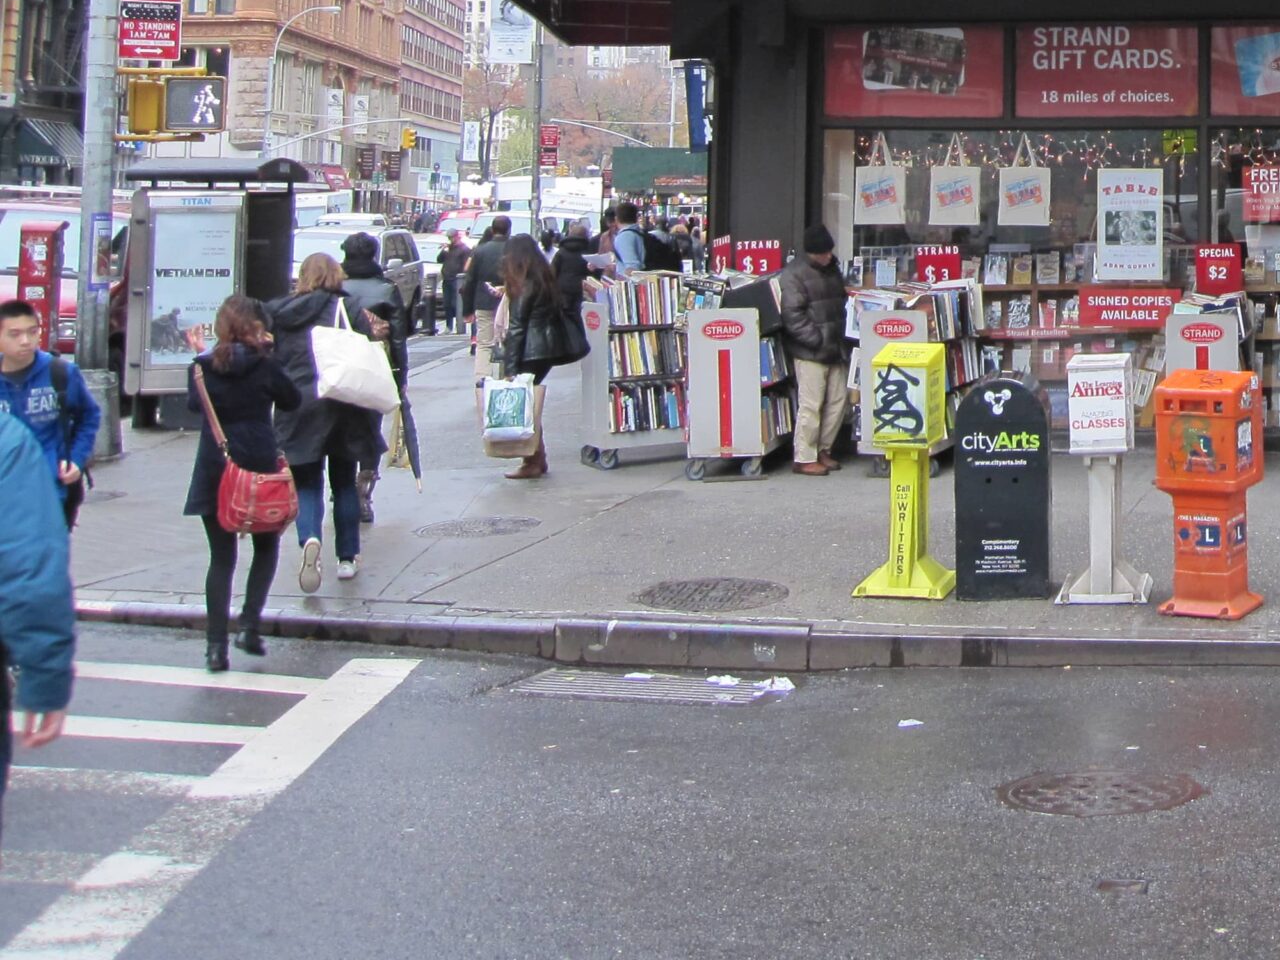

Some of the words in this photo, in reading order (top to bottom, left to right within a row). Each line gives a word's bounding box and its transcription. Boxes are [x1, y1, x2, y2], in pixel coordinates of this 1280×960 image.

[124, 21, 135, 30] NO
[138, 22, 176, 31] STANDING
[1033, 26, 1130, 47] STRAND
[1033, 49, 1086, 70] GIFT
[1094, 48, 1181, 69] CARDS.
[1041, 91, 1059, 103] 18
[1063, 90, 1098, 103] miles
[1102, 90, 1116, 103] of
[1119, 90, 1174, 103] choices.
[1102, 183, 1158, 196] TABLE
[181, 197, 212, 206] TITAN
[737, 240, 780, 250] STRAND
[917, 245, 959, 256] STRAND
[1199, 248, 1235, 257] SPECIAL
[156, 268, 204, 278] VIETNAM
[215, 268, 231, 278] HD
[1208, 265, 1228, 279] $2
[1087, 295, 1129, 306] SIGNED
[1132, 295, 1172, 306] COPIES
[1101, 309, 1159, 321] AVAILABLE
[705, 325, 742, 335] STRAND
[876, 324, 911, 333] STRAND
[1006, 329, 1029, 337] Strand
[1183, 329, 1221, 338] STRAND
[1071, 381, 1123, 398] Annex
[1071, 418, 1125, 430] CLASSES
[962, 431, 1040, 453] cityArts
[896, 484, 910, 493] Call
[1205, 527, 1214, 542] L
